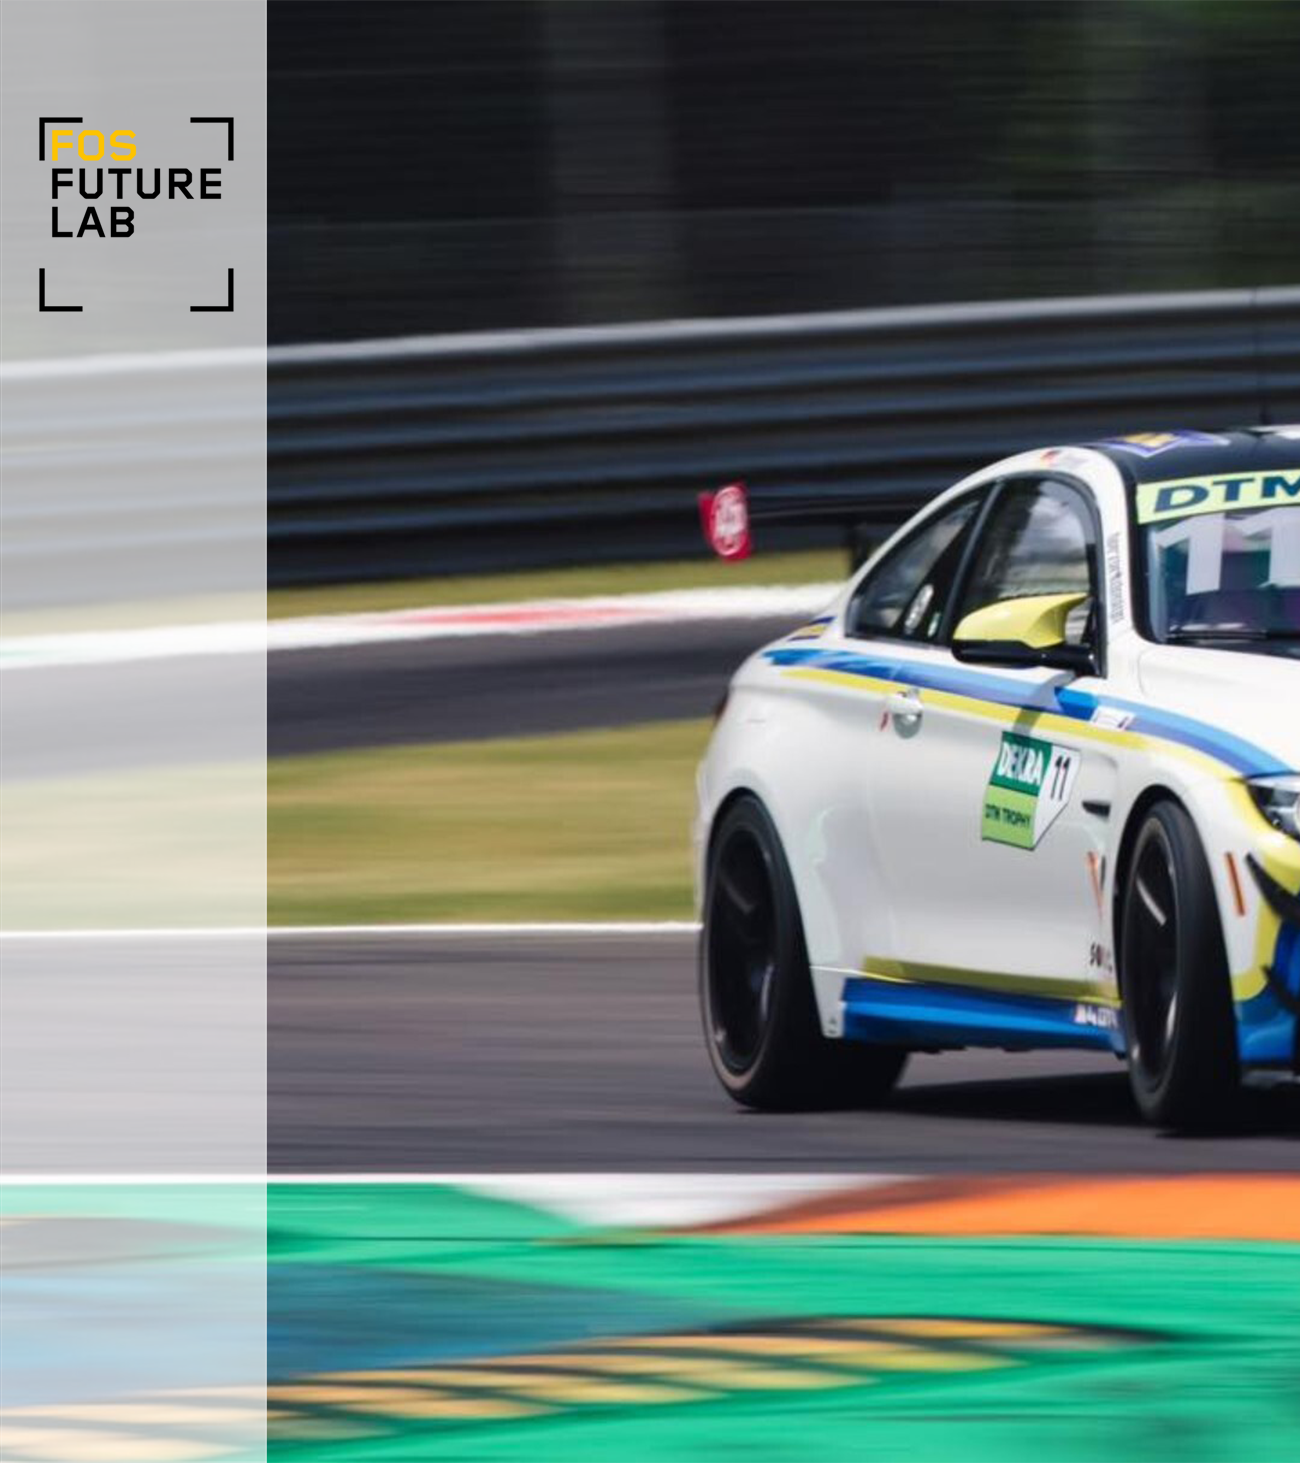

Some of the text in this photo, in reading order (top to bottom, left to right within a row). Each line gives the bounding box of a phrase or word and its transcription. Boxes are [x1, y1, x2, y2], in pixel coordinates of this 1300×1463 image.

[995, 741, 1044, 787] DEKRA
[1048, 755, 1072, 802] 11
[1001, 807, 1031, 829] TROPHY
